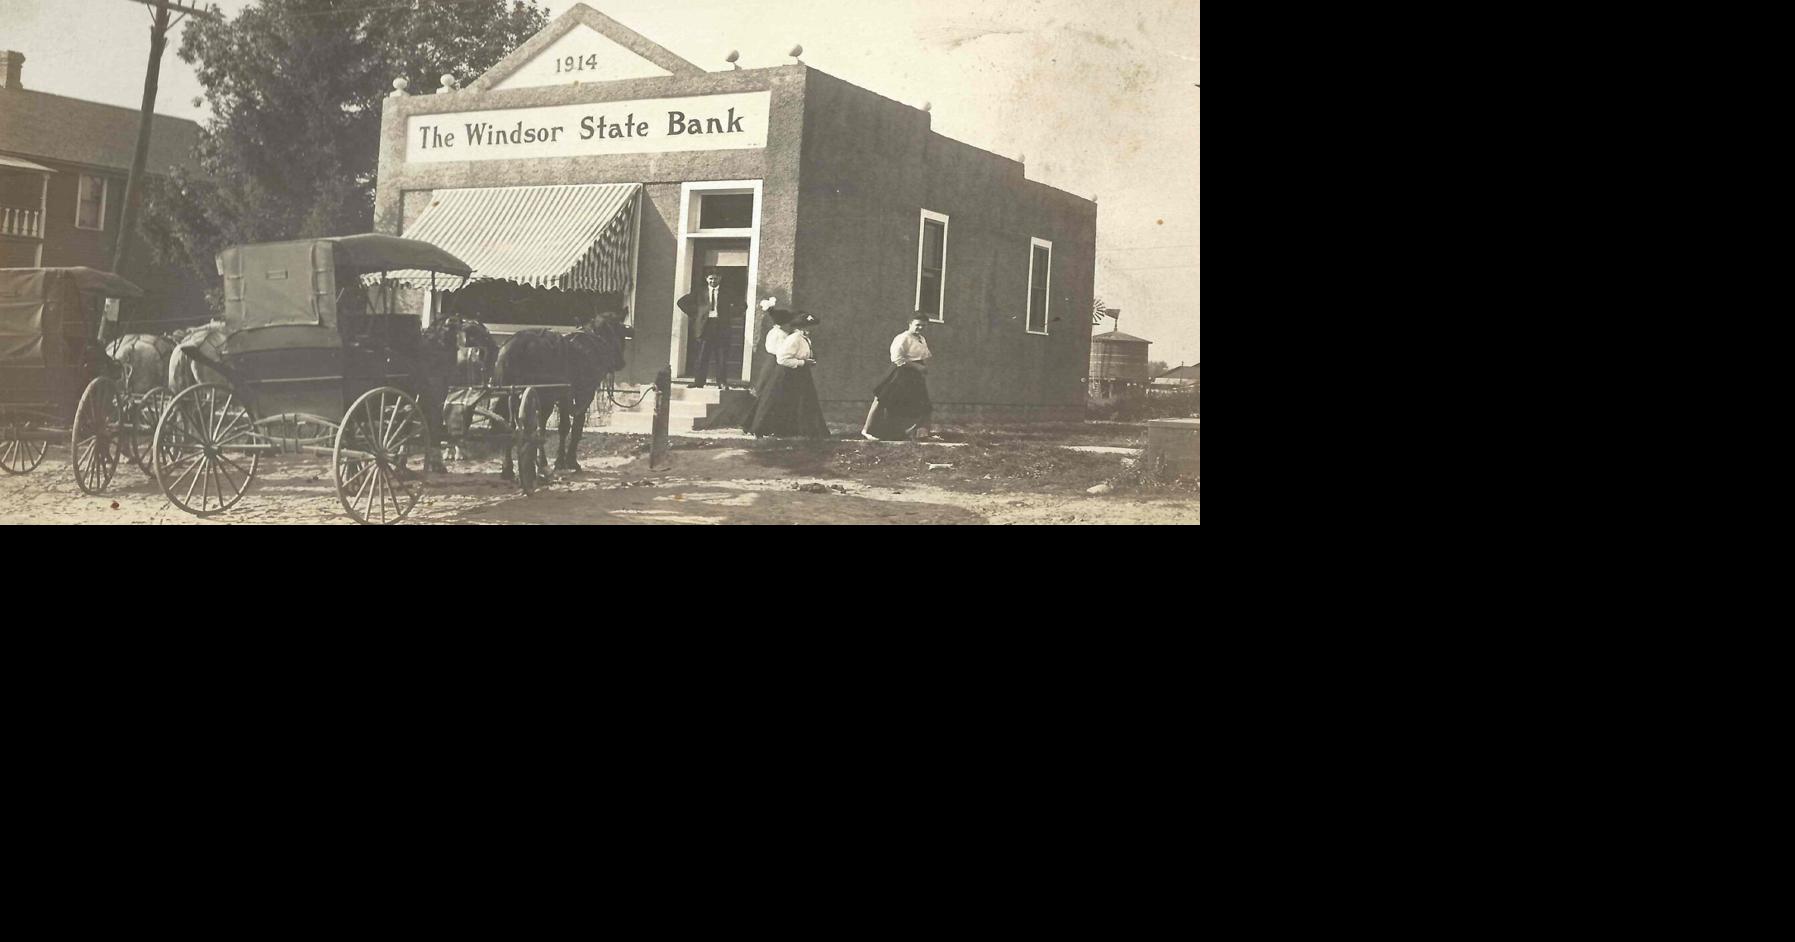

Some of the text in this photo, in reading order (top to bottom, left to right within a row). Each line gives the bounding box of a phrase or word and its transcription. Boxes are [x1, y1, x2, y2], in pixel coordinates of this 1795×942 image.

[556, 53, 598, 73] 1914
[419, 106, 744, 149] The Windsor State Bank
